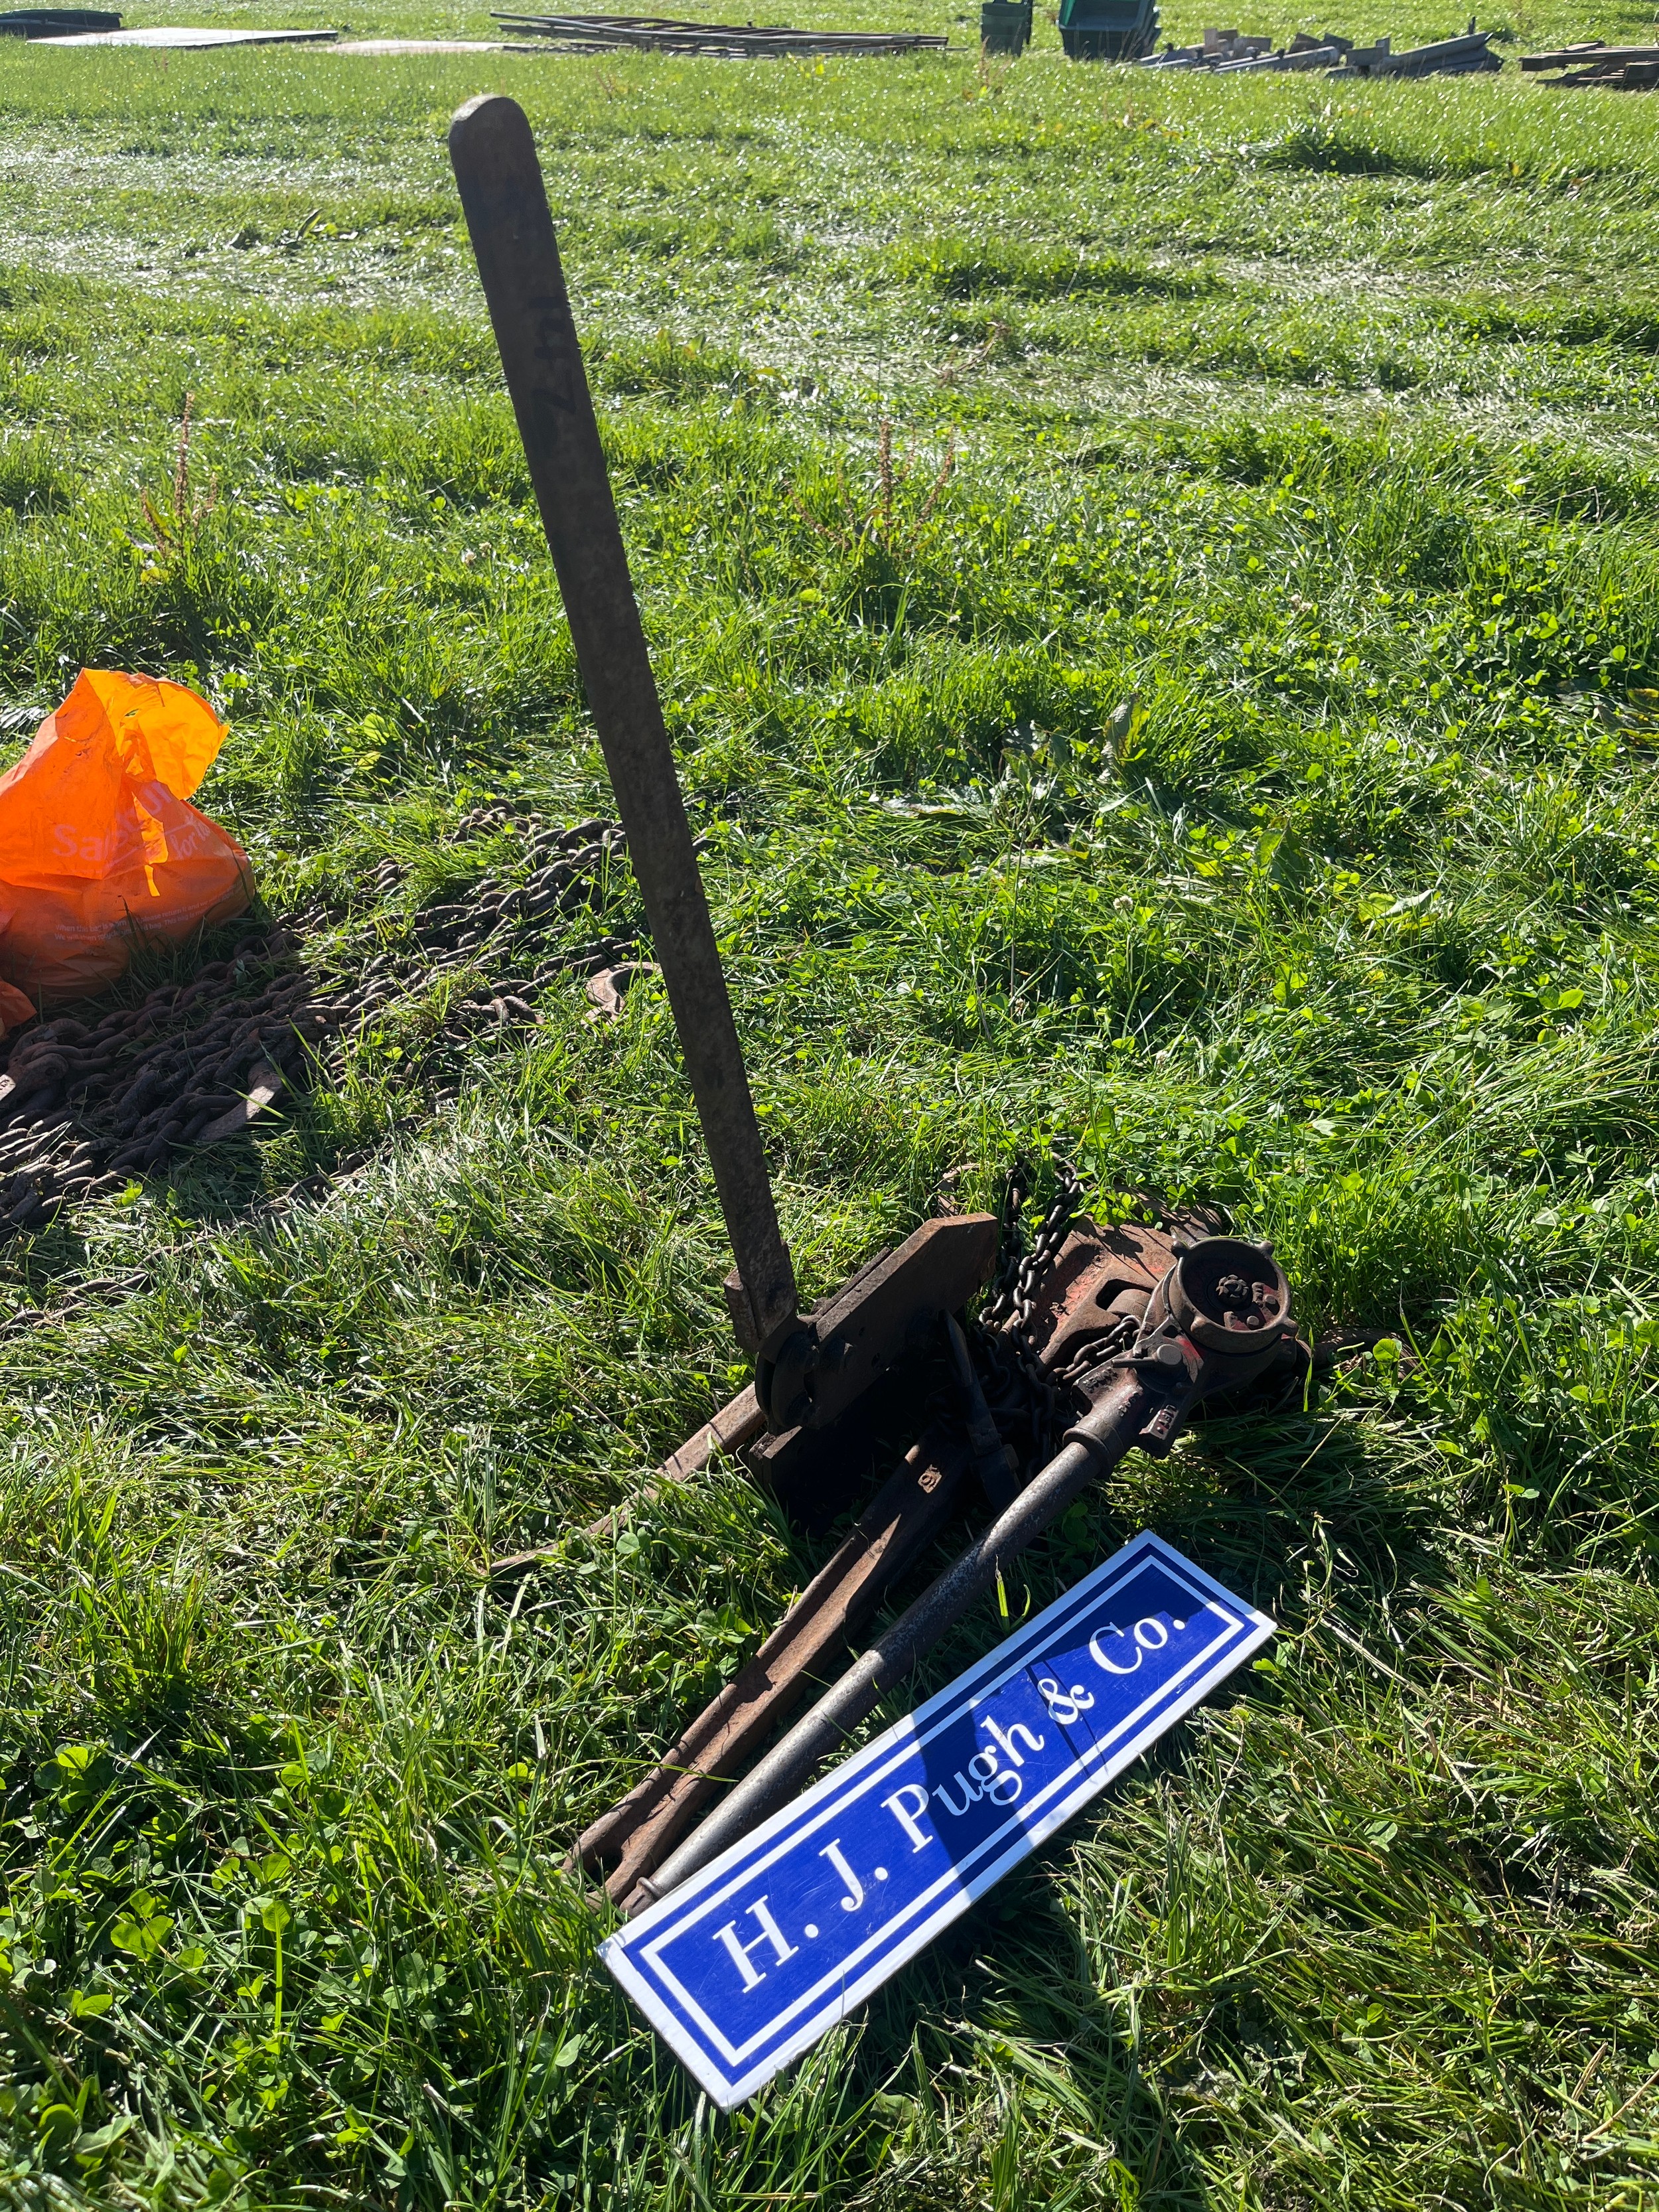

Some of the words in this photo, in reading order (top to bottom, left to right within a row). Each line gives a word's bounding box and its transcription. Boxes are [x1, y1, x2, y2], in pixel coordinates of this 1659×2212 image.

[162, 909, 181, 917] return
[187, 904, 200, 913] and
[711, 1895, 820, 1994] H.
[818, 1838, 889, 1912] J.
[881, 1715, 1045, 1854] Pugh
[1038, 1678, 1095, 1725] &
[1088, 1617, 1186, 1674] Co.
